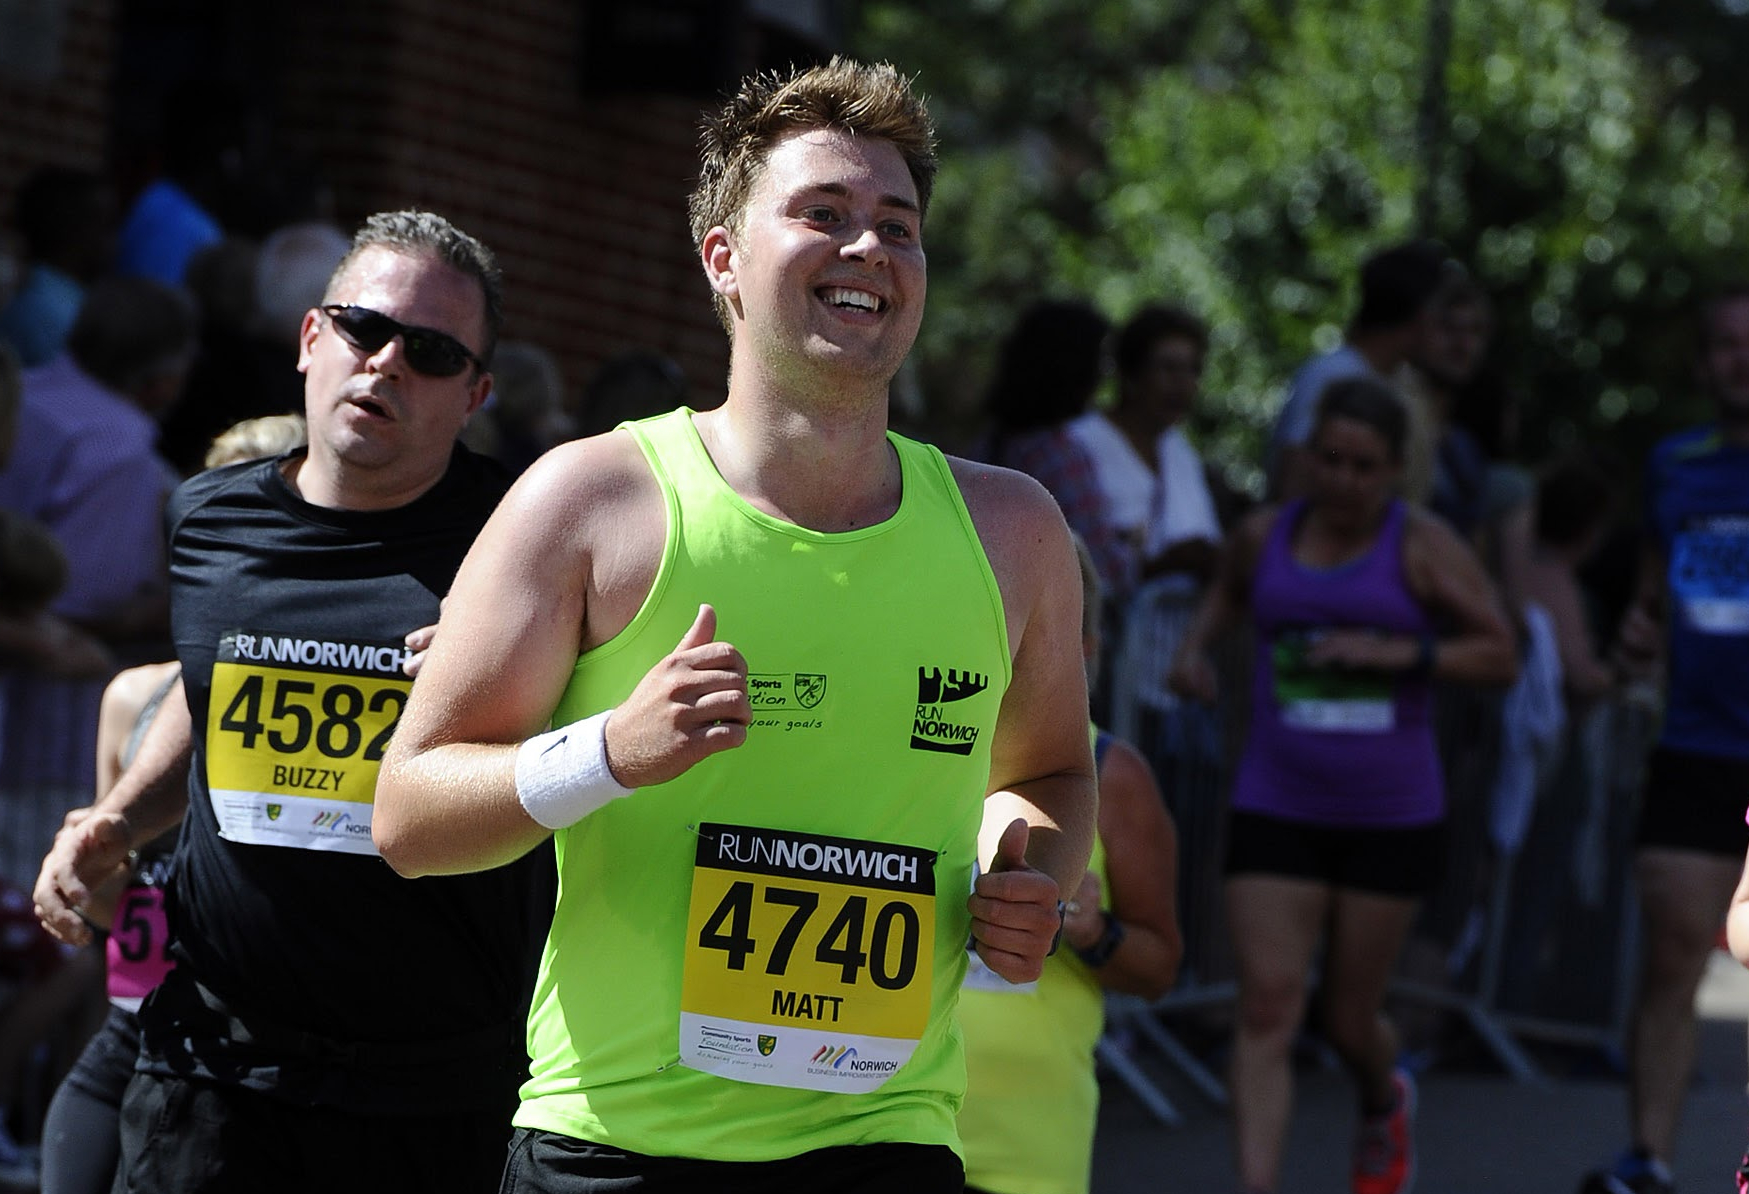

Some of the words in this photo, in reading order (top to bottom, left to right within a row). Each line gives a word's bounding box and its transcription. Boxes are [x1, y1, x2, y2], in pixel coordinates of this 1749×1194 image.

[751, 678, 782, 690] Sports
[220, 674, 408, 761] 4582
[915, 704, 944, 721] RUN
[749, 719, 780, 729] your
[785, 718, 823, 732] goals
[912, 719, 980, 742] NORWICH
[273, 764, 346, 791] BUZZY
[699, 881, 921, 991] 4740
[771, 990, 843, 1022] MATT
[701, 1029, 733, 1041] Community
[733, 1035, 752, 1044] Sports
[701, 1036, 754, 1054] Foundation
[850, 1060, 898, 1072] NORWICH
